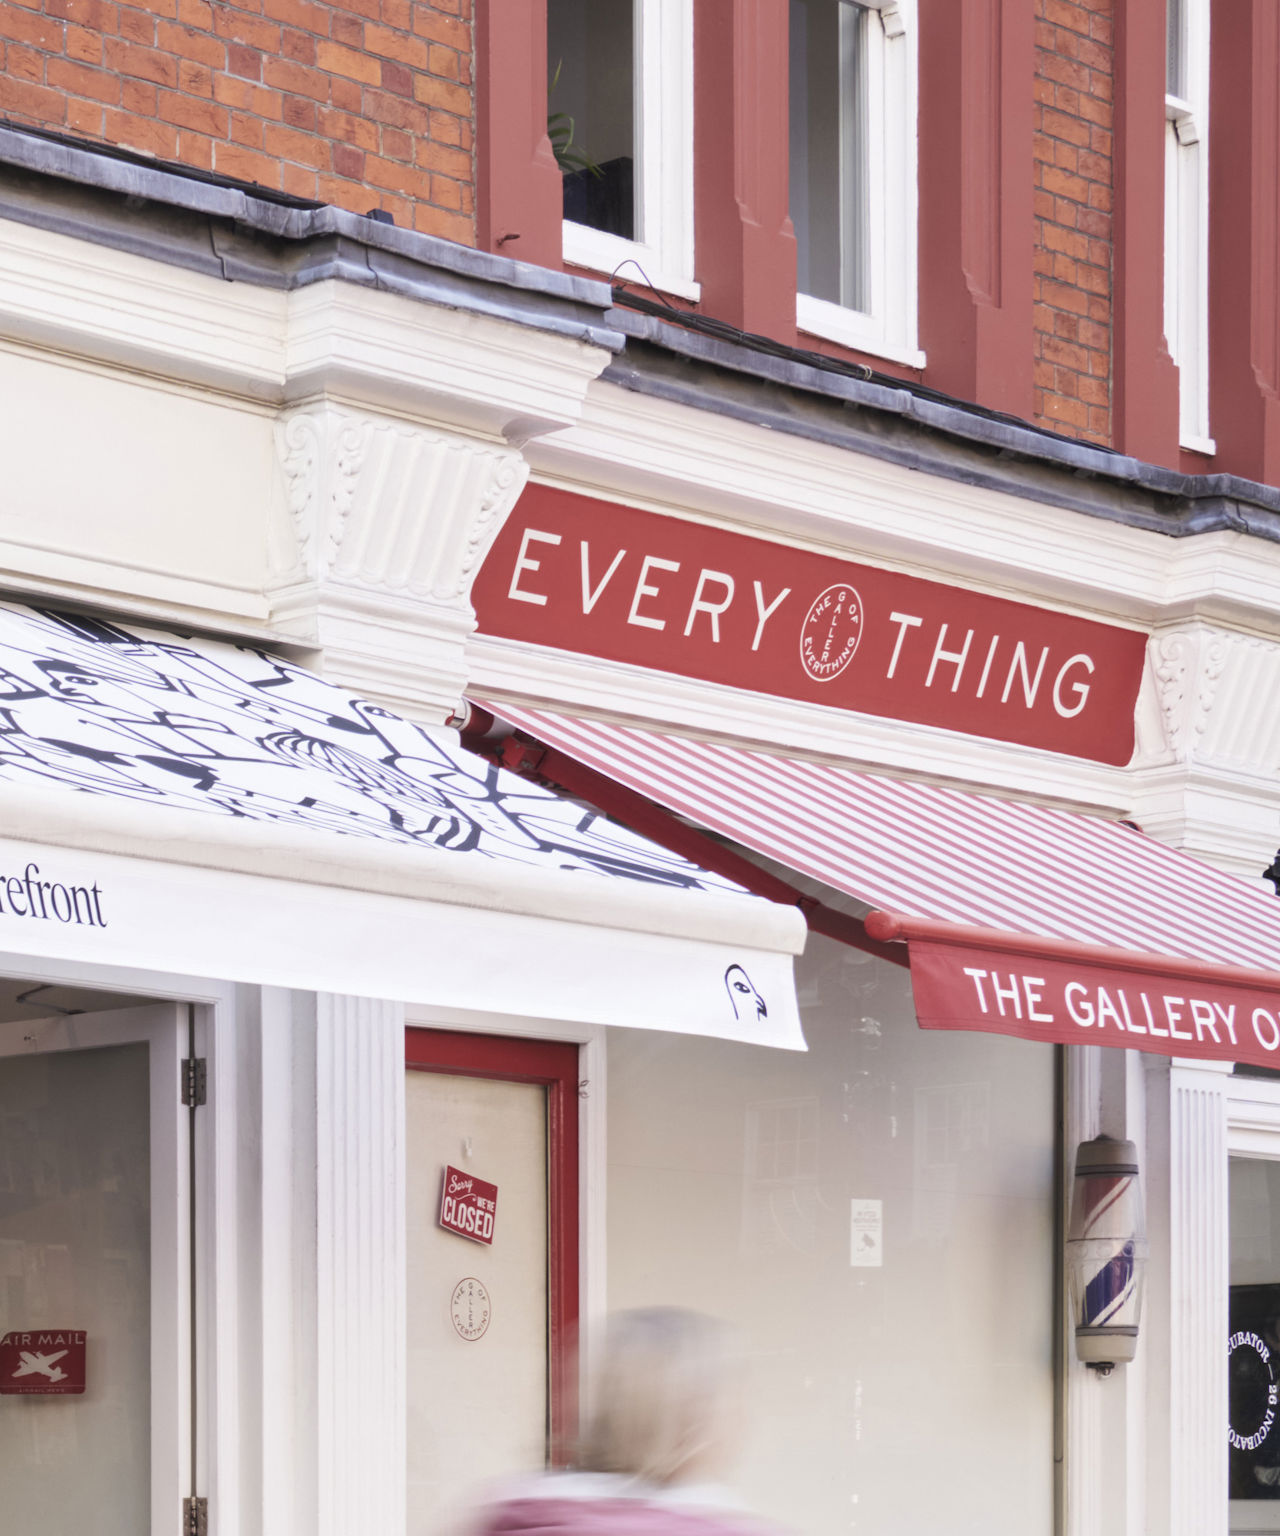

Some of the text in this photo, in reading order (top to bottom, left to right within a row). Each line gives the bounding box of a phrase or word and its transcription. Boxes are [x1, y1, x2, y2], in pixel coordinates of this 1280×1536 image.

[508, 527, 1096, 719] EVERY THING
[963, 967, 1280, 1051] THE GALLERY O
[448, 1175, 473, 1193] Sorry
[443, 1196, 494, 1239] CLOSED
[1, 1332, 85, 1346] AIR MAIL
[1228, 1408, 1275, 1451] INCUBATO
